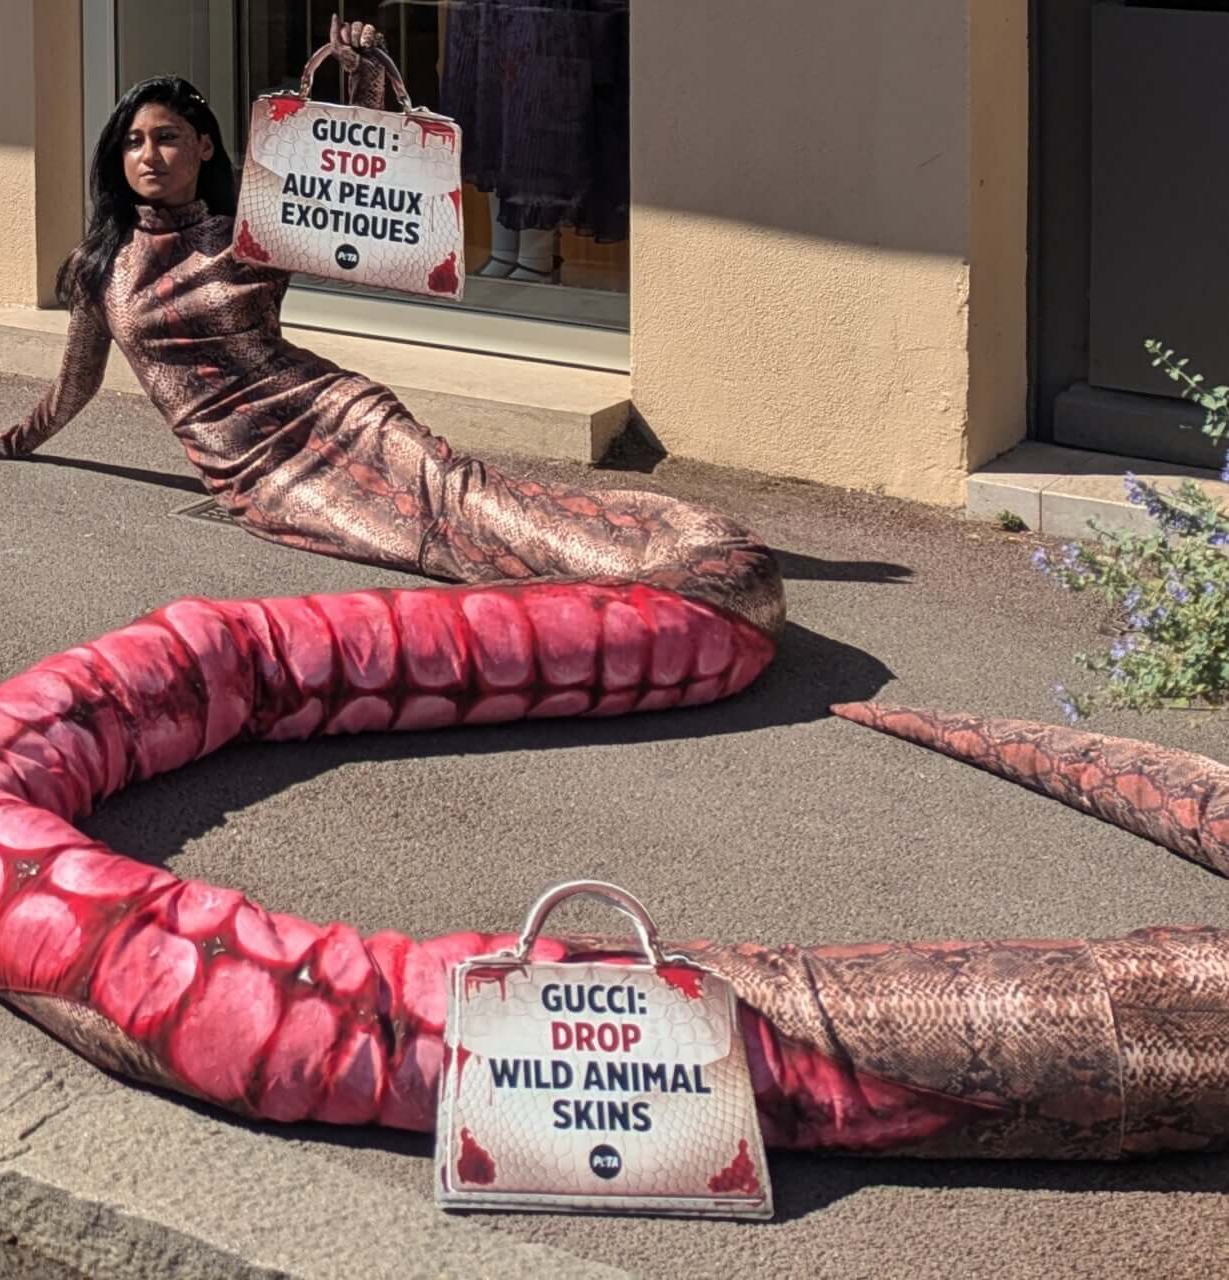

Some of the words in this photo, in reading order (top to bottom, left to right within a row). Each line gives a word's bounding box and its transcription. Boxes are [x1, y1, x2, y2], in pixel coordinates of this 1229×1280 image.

[320, 149, 387, 178] STOP
[282, 173, 333, 201] AUX
[339, 181, 423, 216] PEAUX
[281, 202, 420, 245] EXOTIQUES
[541, 983, 647, 1015] GUCCI:
[551, 1021, 642, 1052] DROP
[489, 1058, 572, 1089] WILD
[583, 1061, 711, 1094] ANIMAL
[552, 1099, 653, 1132] SKINS
